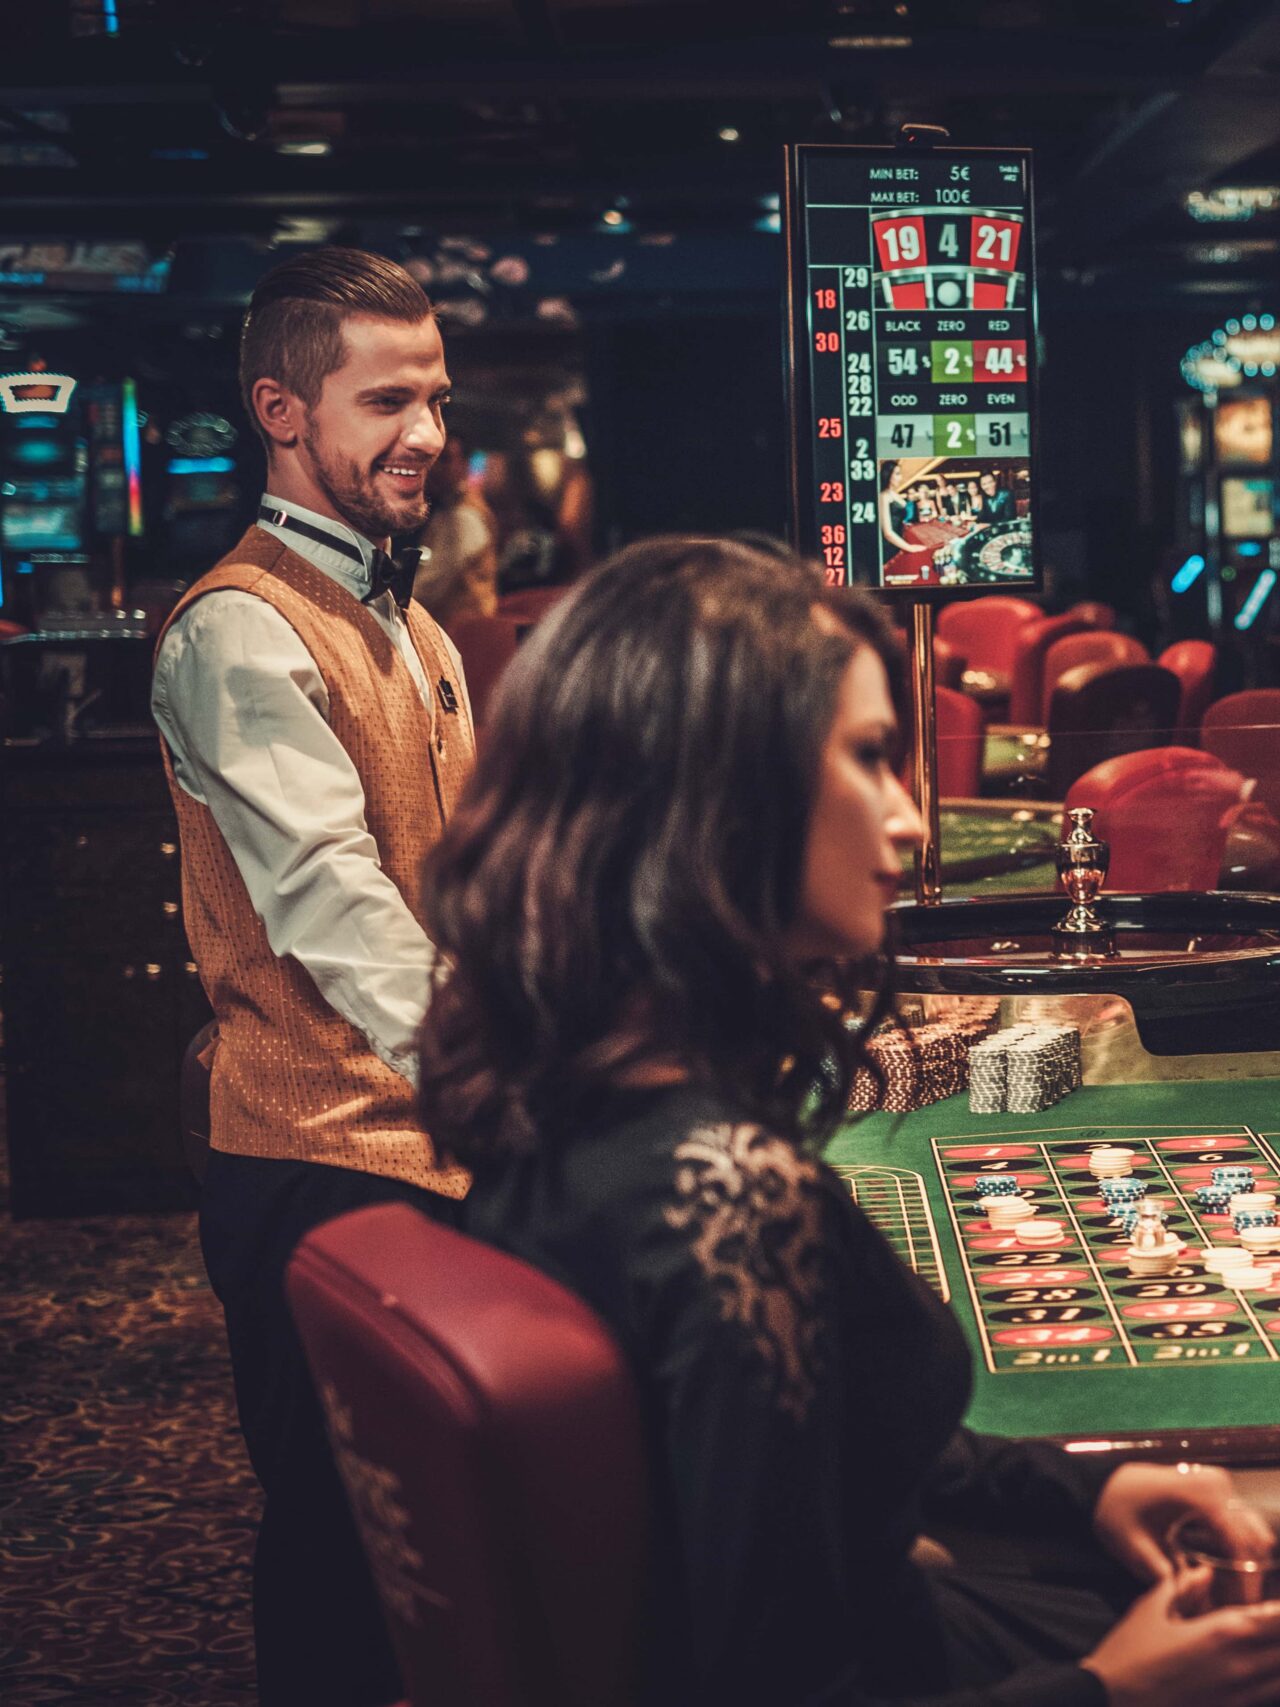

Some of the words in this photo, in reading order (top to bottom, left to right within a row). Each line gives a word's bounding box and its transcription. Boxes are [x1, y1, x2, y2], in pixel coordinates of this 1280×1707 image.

[869, 168, 893, 180] MIN
[895, 169, 919, 180] BET:
[950, 166, 970, 181] 5€
[870, 192, 894, 203] MAX
[896, 192, 919, 203] BET:
[935, 189, 970, 203] 100€
[882, 225, 920, 261] 19
[939, 224, 959, 257] 4
[976, 225, 1012, 261] 21
[844, 268, 869, 287] 29
[815, 289, 837, 309] 18
[846, 310, 870, 331] 26
[885, 320, 921, 332] BLACK
[937, 320, 966, 332] ZERO
[988, 320, 1010, 331] RED
[815, 332, 839, 352] 30
[847, 353, 871, 373] 24
[848, 375, 872, 395] 28
[848, 396, 872, 416] 22
[891, 395, 918, 406] ODD
[939, 394, 968, 406] ZERO
[987, 394, 1015, 405] EVEN
[818, 418, 842, 439] 25
[855, 438, 869, 459] 2
[850, 459, 875, 481] 33
[820, 482, 843, 502] 23
[852, 502, 876, 523] 24
[821, 525, 845, 544] 36
[823, 546, 843, 565] 12
[825, 568, 844, 586] 27
[984, 1148, 1002, 1156] 1
[1189, 1139, 1216, 1149] 3
[1198, 1153, 1223, 1161] 6
[981, 1161, 1008, 1170] 4
[995, 1253, 1062, 1265] 22
[1000, 1271, 1070, 1284] 25
[1005, 1289, 1077, 1302] 28
[1137, 1284, 1206, 1297] 29
[1011, 1308, 1081, 1322] 31
[1144, 1303, 1217, 1318] 32
[1015, 1328, 1091, 1344] 34
[1152, 1322, 1227, 1338] 35
